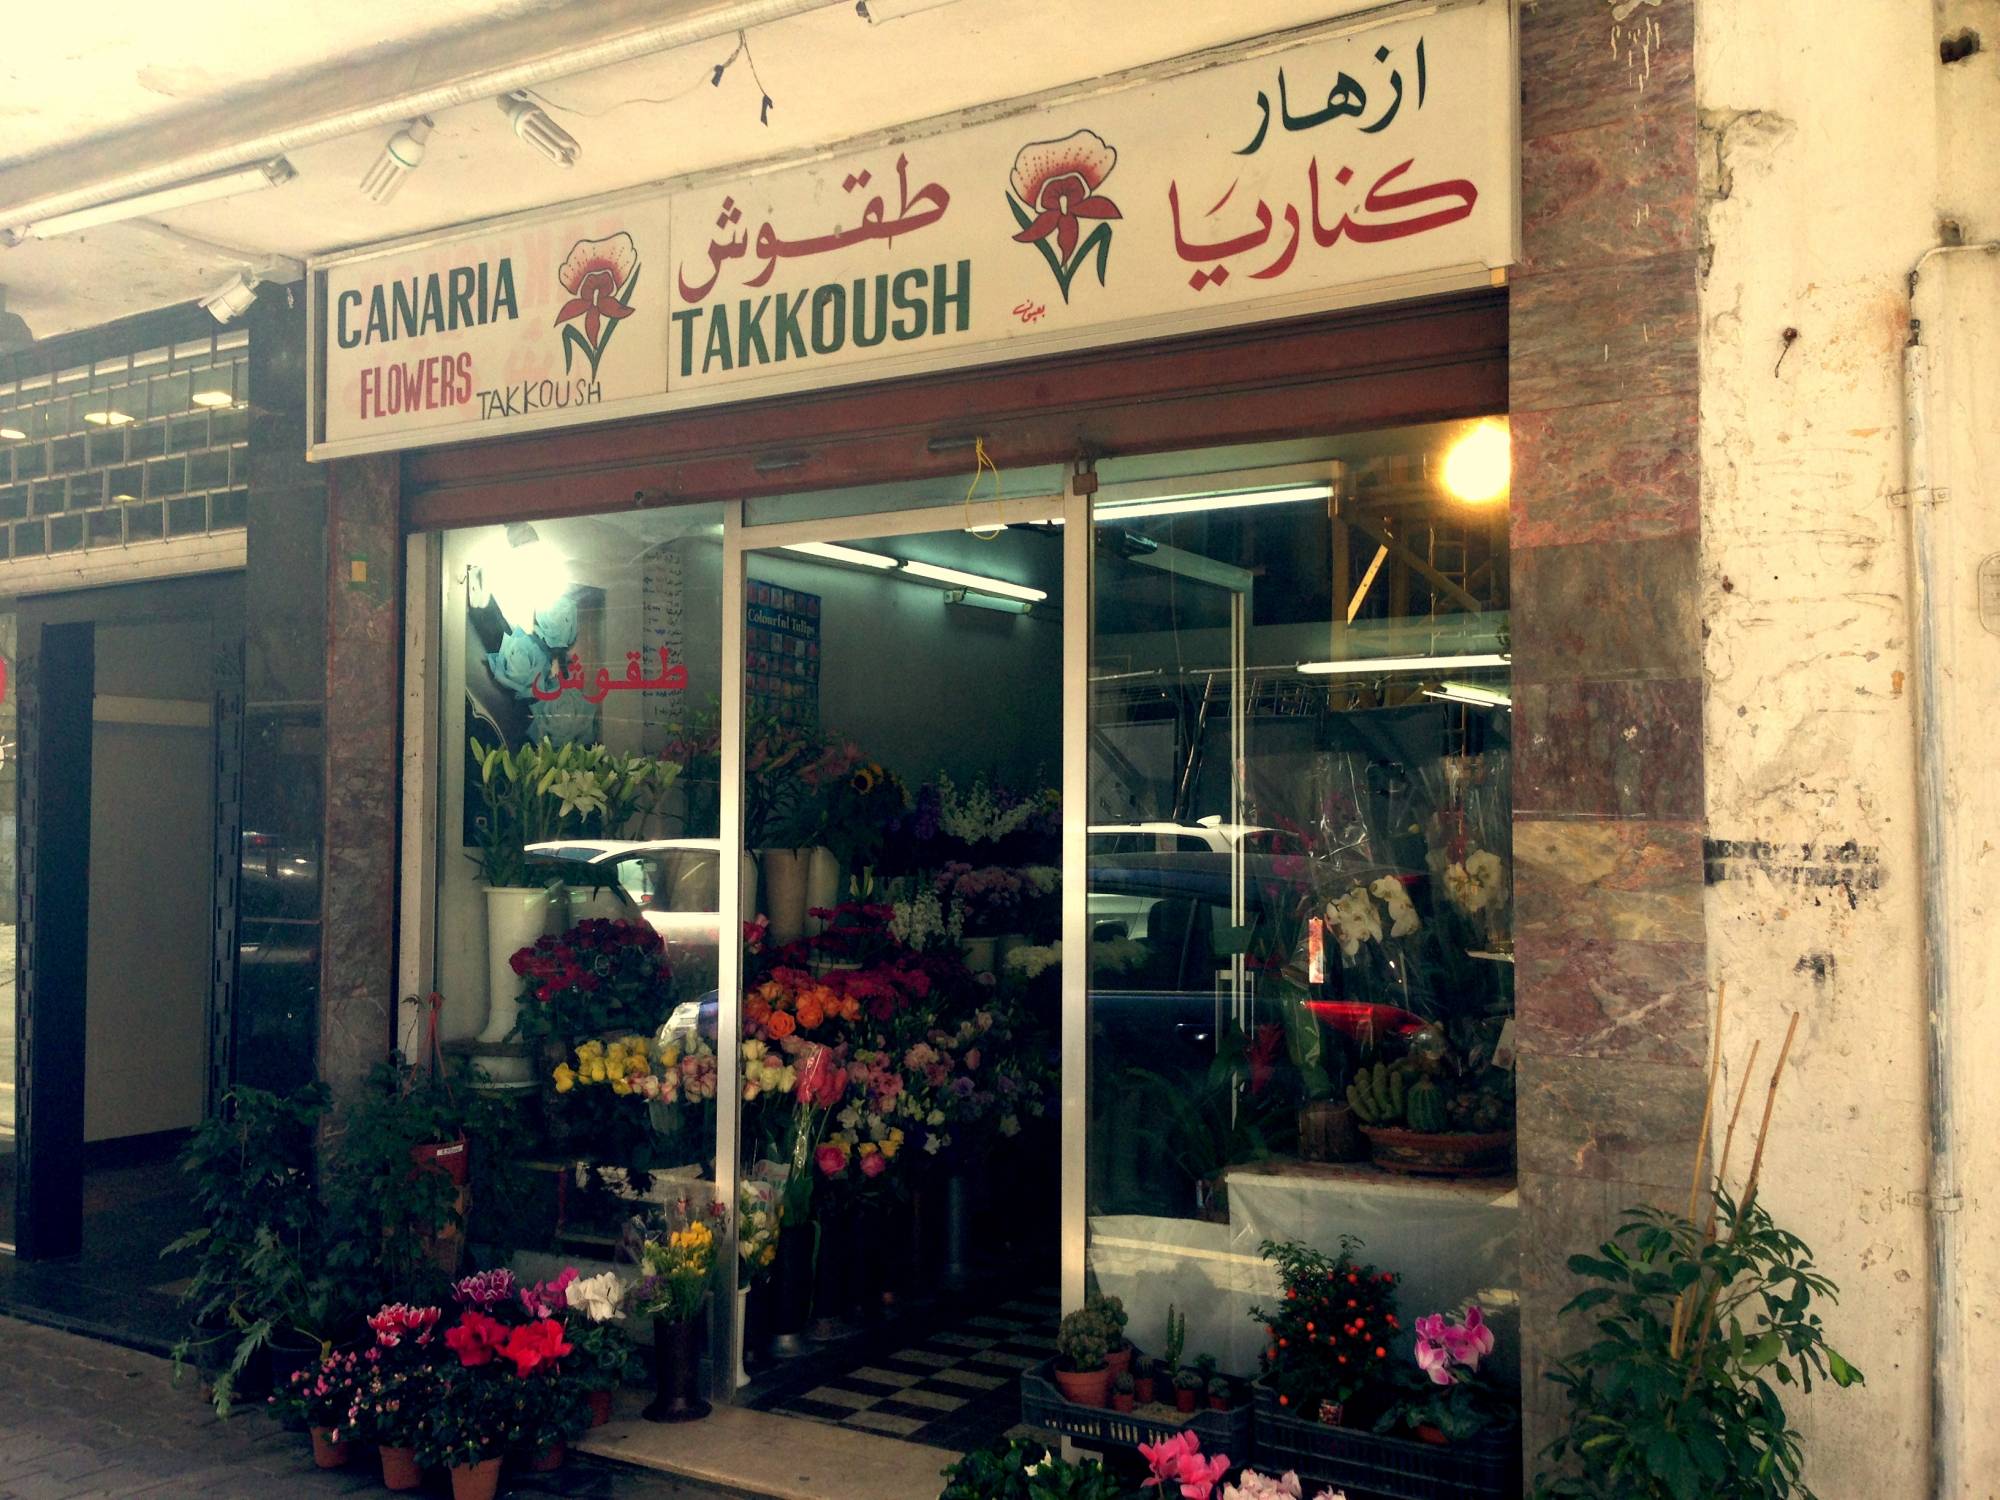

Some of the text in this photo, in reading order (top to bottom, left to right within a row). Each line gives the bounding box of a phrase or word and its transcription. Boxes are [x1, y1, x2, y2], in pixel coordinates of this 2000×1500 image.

[1232, 36, 1426, 155] ازهار
[678, 152, 950, 304] طقوش
[1168, 155, 1478, 292] كناريا
[338, 257, 519, 349] CANARIA
[671, 259, 970, 377] TAKKOUSH
[360, 351, 472, 420] FLOWERS
[476, 378, 601, 421] TAKKOUSH
[747, 608, 790, 629] Colourful
[531, 645, 688, 704] طقوش
